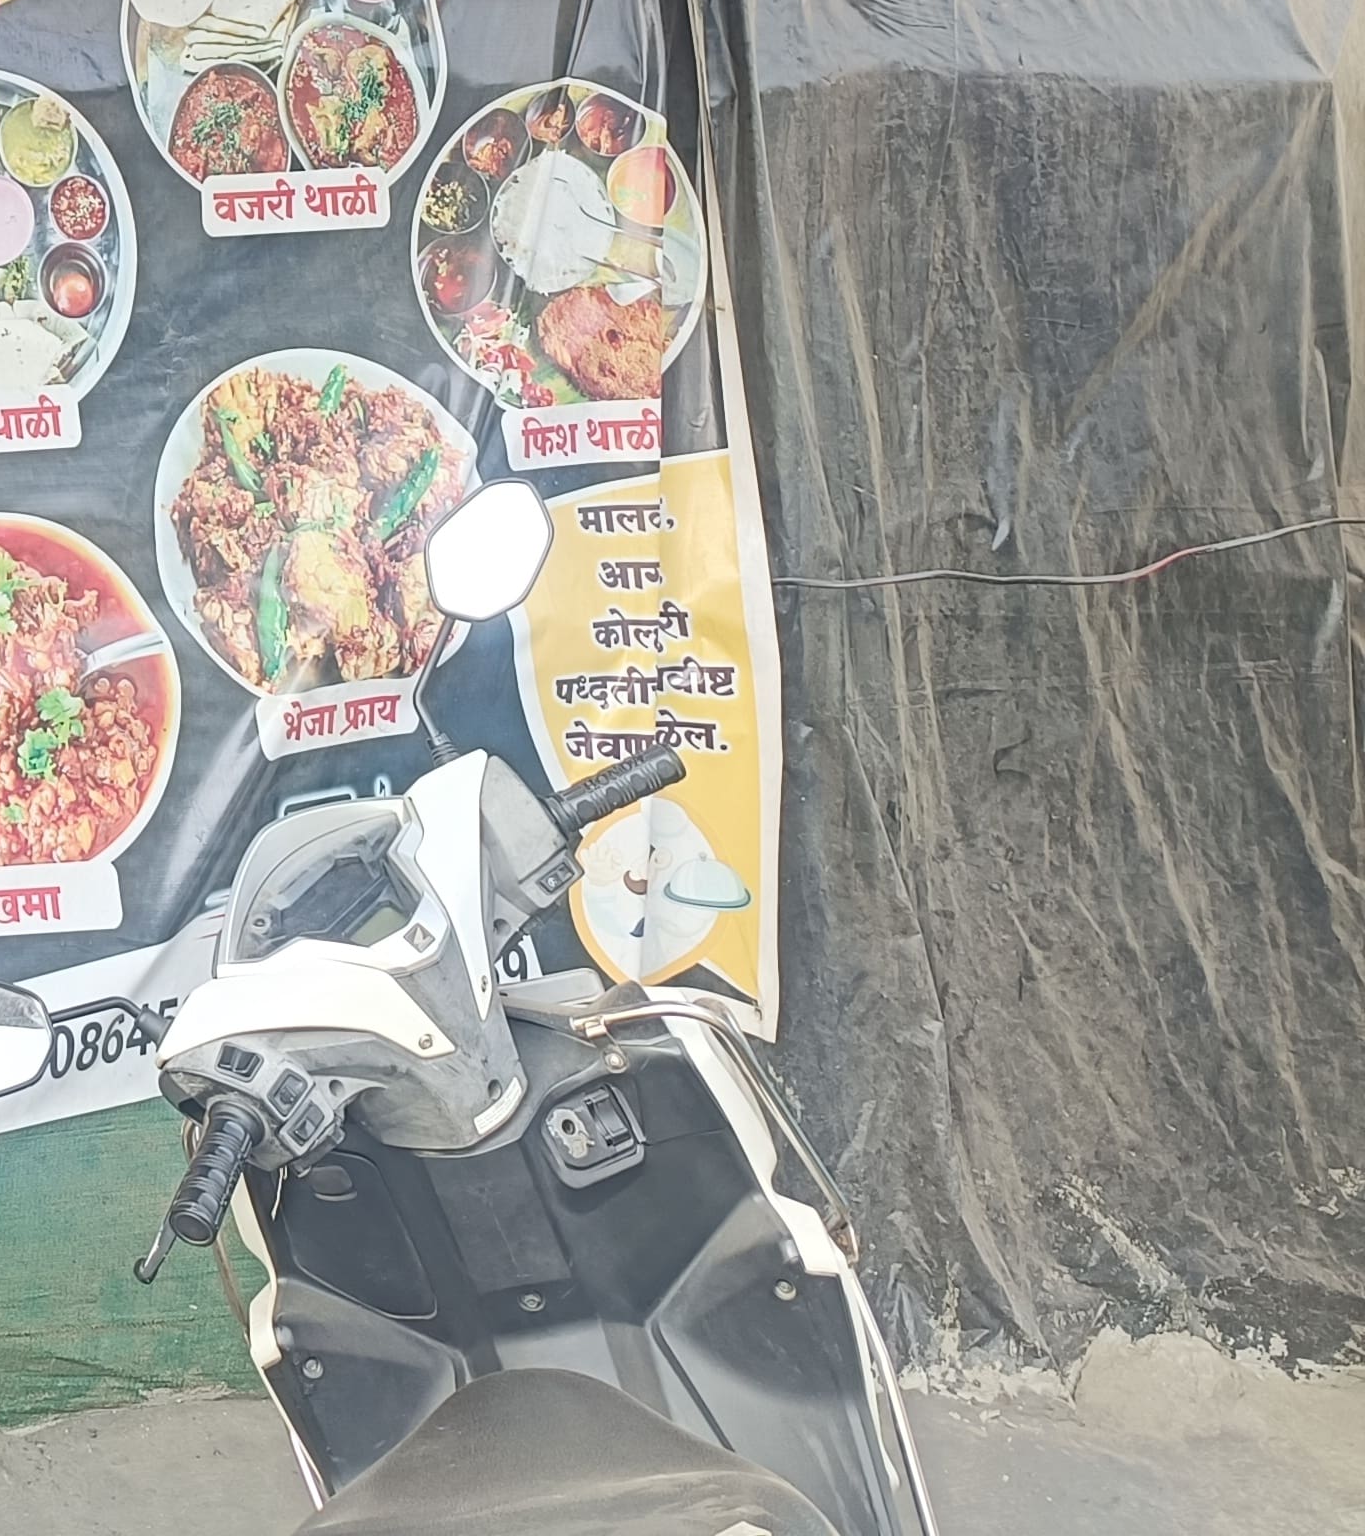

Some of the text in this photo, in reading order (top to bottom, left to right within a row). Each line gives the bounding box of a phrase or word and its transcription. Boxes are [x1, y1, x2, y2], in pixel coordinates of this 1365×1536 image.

[213, 173, 377, 222] वजरी थाळी
[521, 416, 578, 458] फिश
[283, 694, 401, 741] भेजा फ्राय
